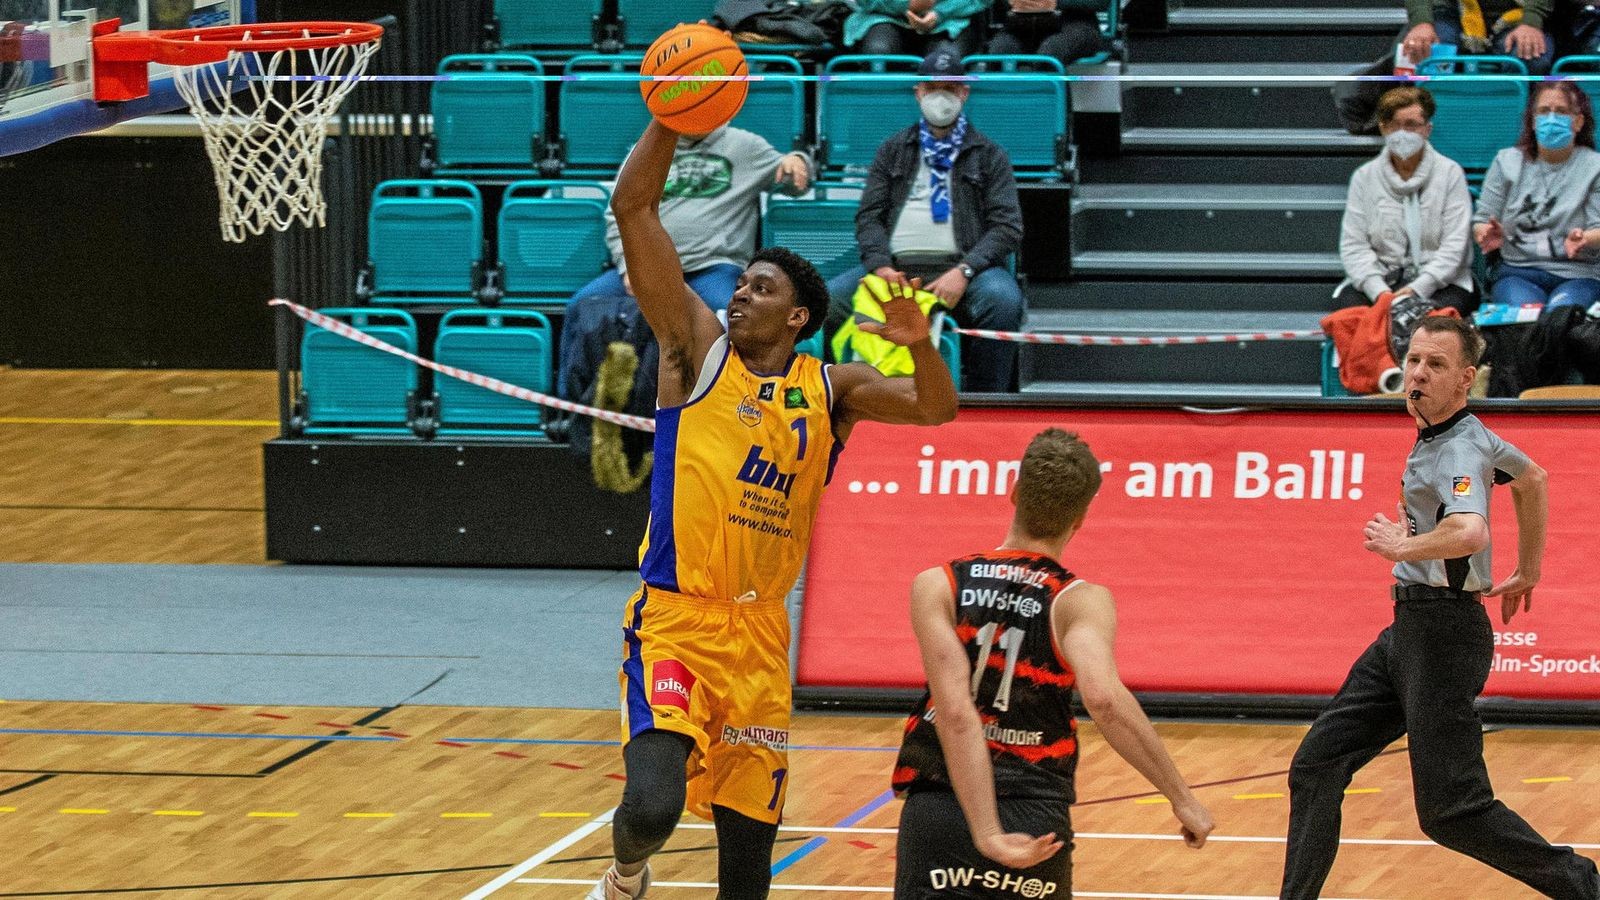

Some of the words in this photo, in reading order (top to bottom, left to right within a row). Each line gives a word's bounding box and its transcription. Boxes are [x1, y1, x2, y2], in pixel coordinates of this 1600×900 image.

[790, 416, 808, 461] 1
[743, 488, 769, 505] When
[1124, 461, 1214, 499] am
[1233, 449, 1365, 501] Ball!
[972, 621, 1026, 712] 11
[767, 768, 788, 811] 1
[929, 867, 1057, 899] DW-SHOP
